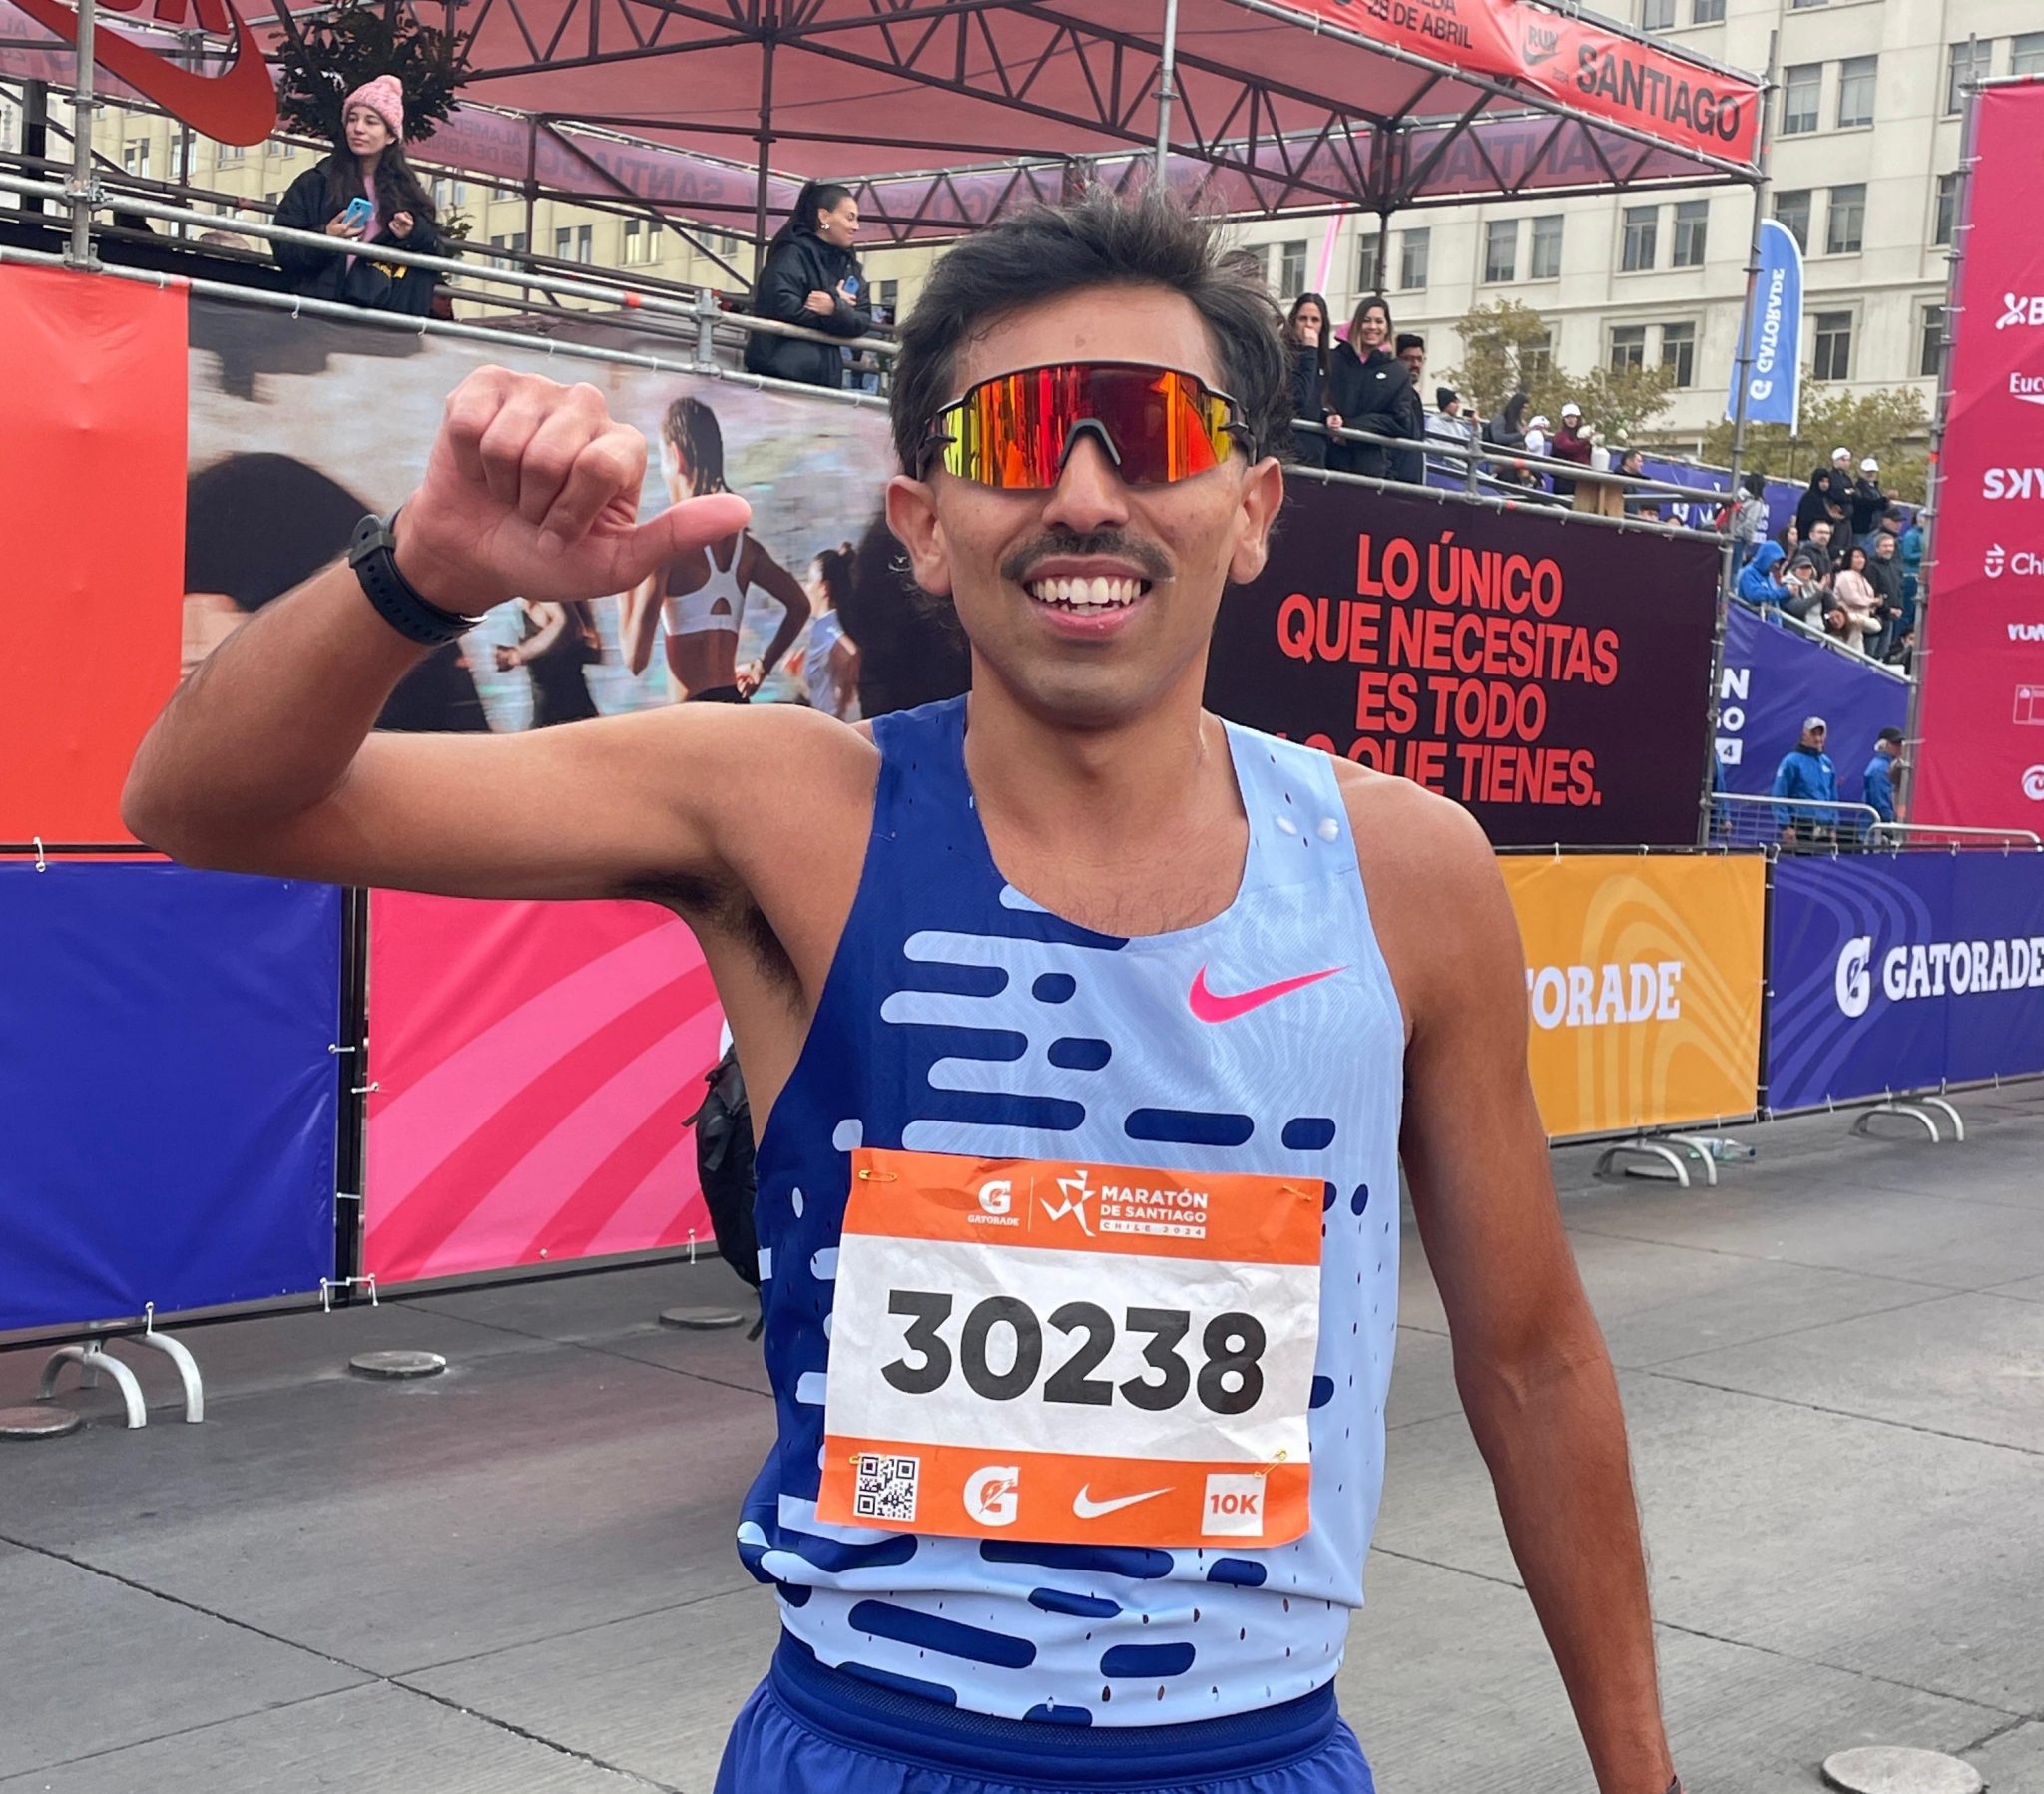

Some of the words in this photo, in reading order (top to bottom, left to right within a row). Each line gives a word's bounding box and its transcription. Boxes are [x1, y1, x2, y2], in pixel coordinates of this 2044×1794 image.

[1393, 2, 1418, 31] DE
[1420, 12, 1473, 49] ABRIL
[1577, 44, 1740, 142] SANTIAGO
[2009, 372, 2044, 393] Euc
[1356, 533, 1419, 600] LO
[1427, 530, 1562, 617] ÚNICO
[2011, 552, 2044, 575] Ch
[1277, 593, 1381, 664] QUE
[1389, 606, 1620, 685] NECESITAS
[1355, 671, 1418, 733] ES
[1427, 675, 1547, 742] TODO
[1456, 742, 1601, 806] TIENES.
[1525, 961, 1682, 1030] ORADE
[1883, 936, 2044, 1002] GATORADE
[967, 1214, 1019, 1227] GATORADE
[1101, 1185, 1208, 1209] MARATÓN
[1101, 1204, 1121, 1217] DE
[1125, 1206, 1207, 1223] SANTIAGO
[1103, 1222, 1151, 1233] CHILE
[1162, 1226, 1203, 1236] 2024
[880, 1289, 1267, 1414] 30238
[1210, 1494, 1258, 1515] 10K
